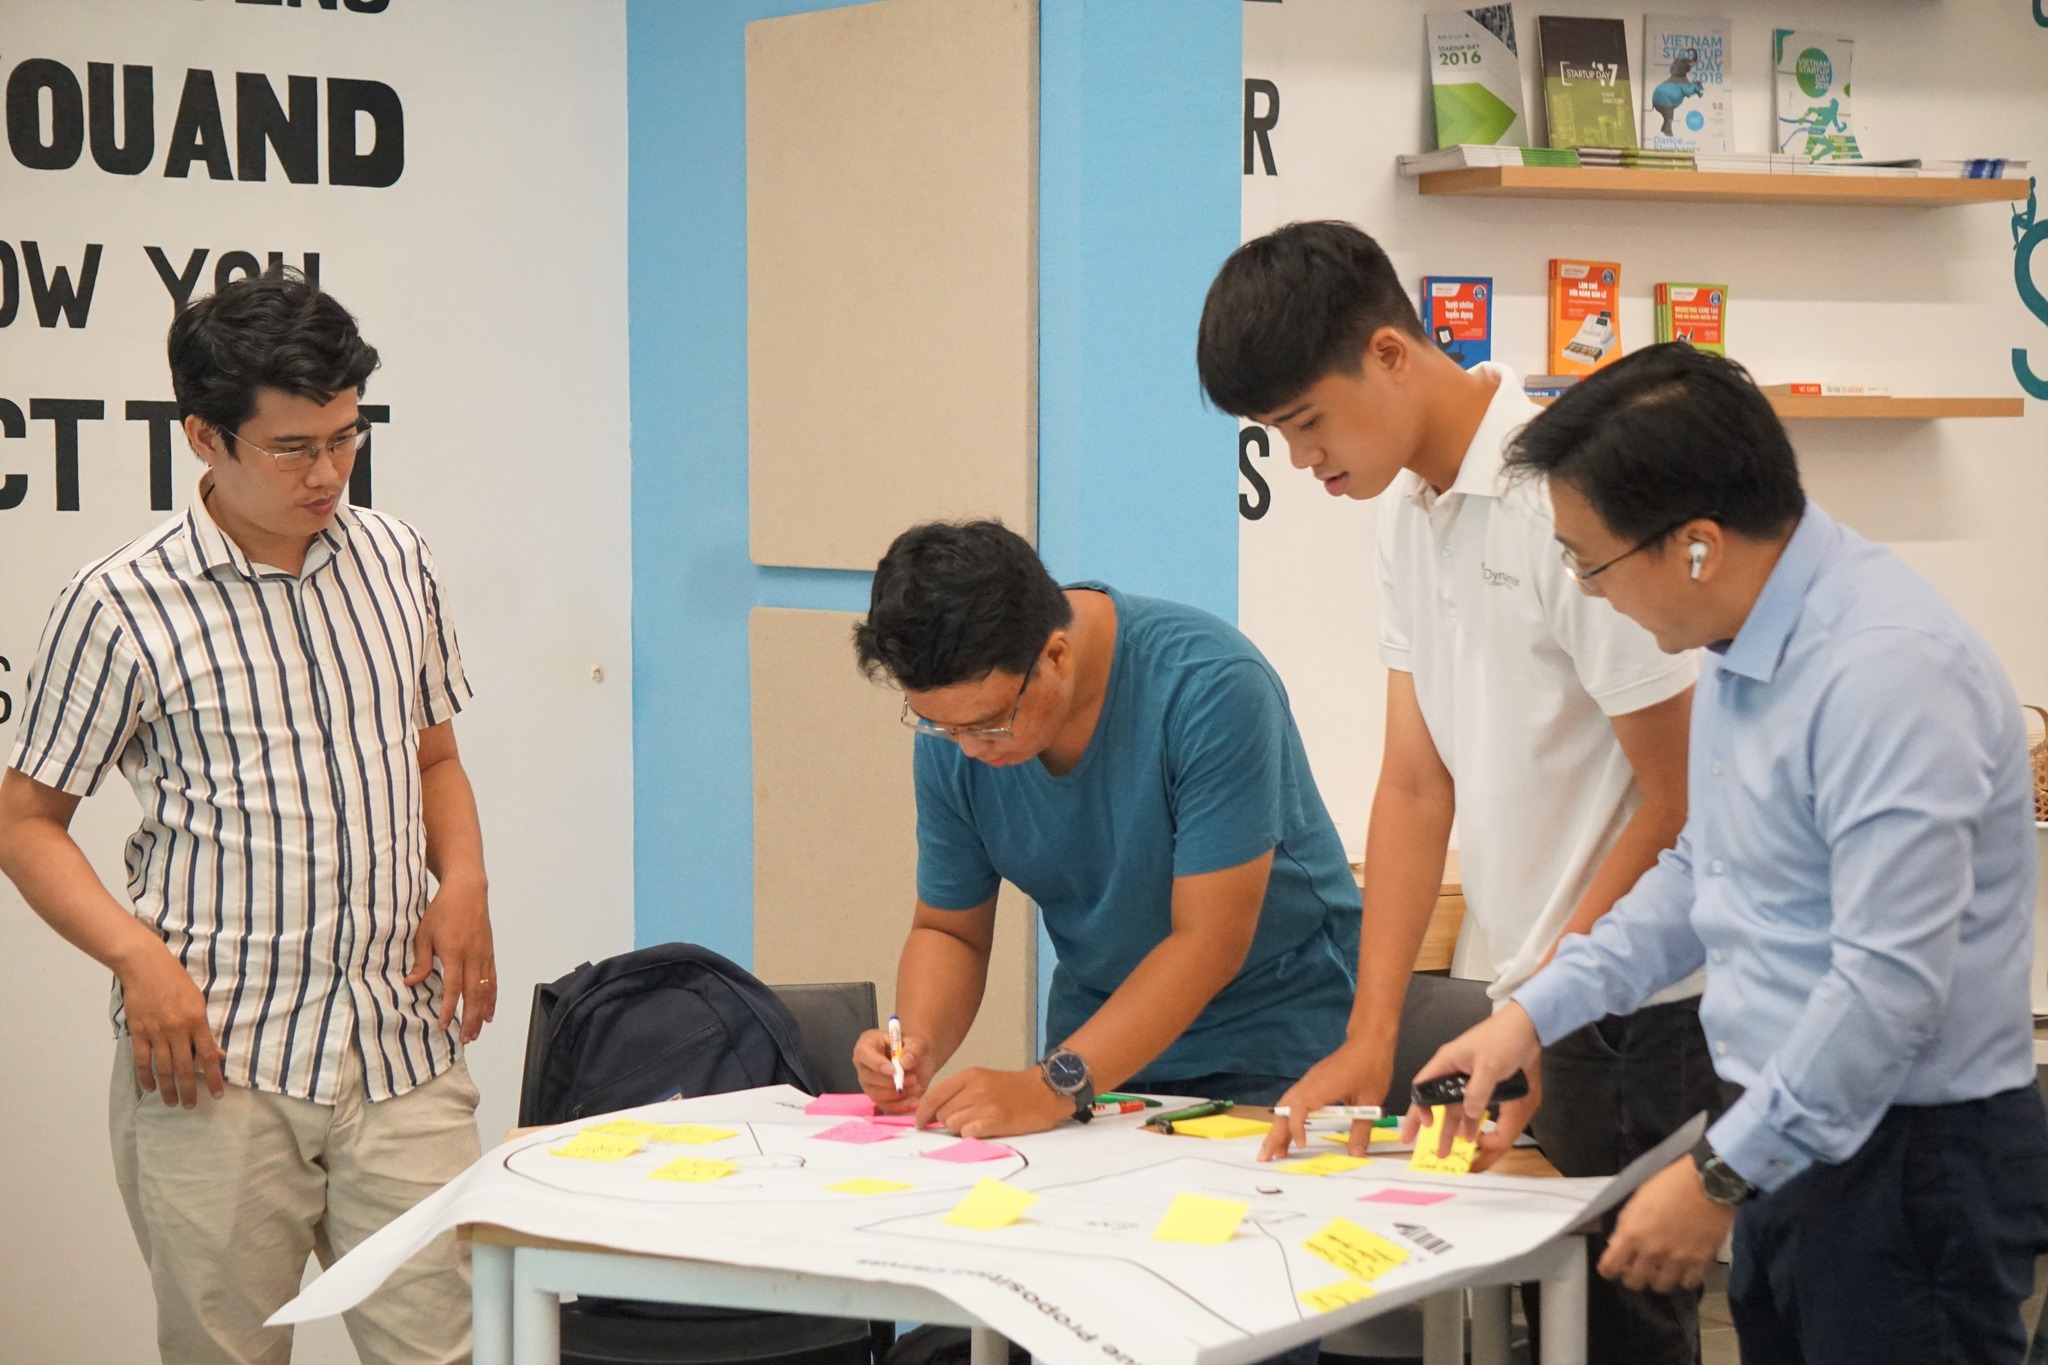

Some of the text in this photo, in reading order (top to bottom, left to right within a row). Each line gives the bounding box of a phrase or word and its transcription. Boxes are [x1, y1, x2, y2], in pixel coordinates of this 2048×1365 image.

[1662, 34, 1722, 48] VIETNAM
[1440, 51, 1482, 66] 2016
[1663, 47, 1723, 60] STARTUP
[1696, 60, 1723, 72] DAY
[1798, 58, 1830, 67] VIETNAM
[1567, 69, 1595, 79] STARTUP
[1596, 70, 1611, 80] DAY
[1799, 65, 1830, 75] STARTUP
[1691, 72, 1723, 84] 2018
[1815, 73, 1830, 82] DAY
[1653, 136, 1684, 145] Dance
